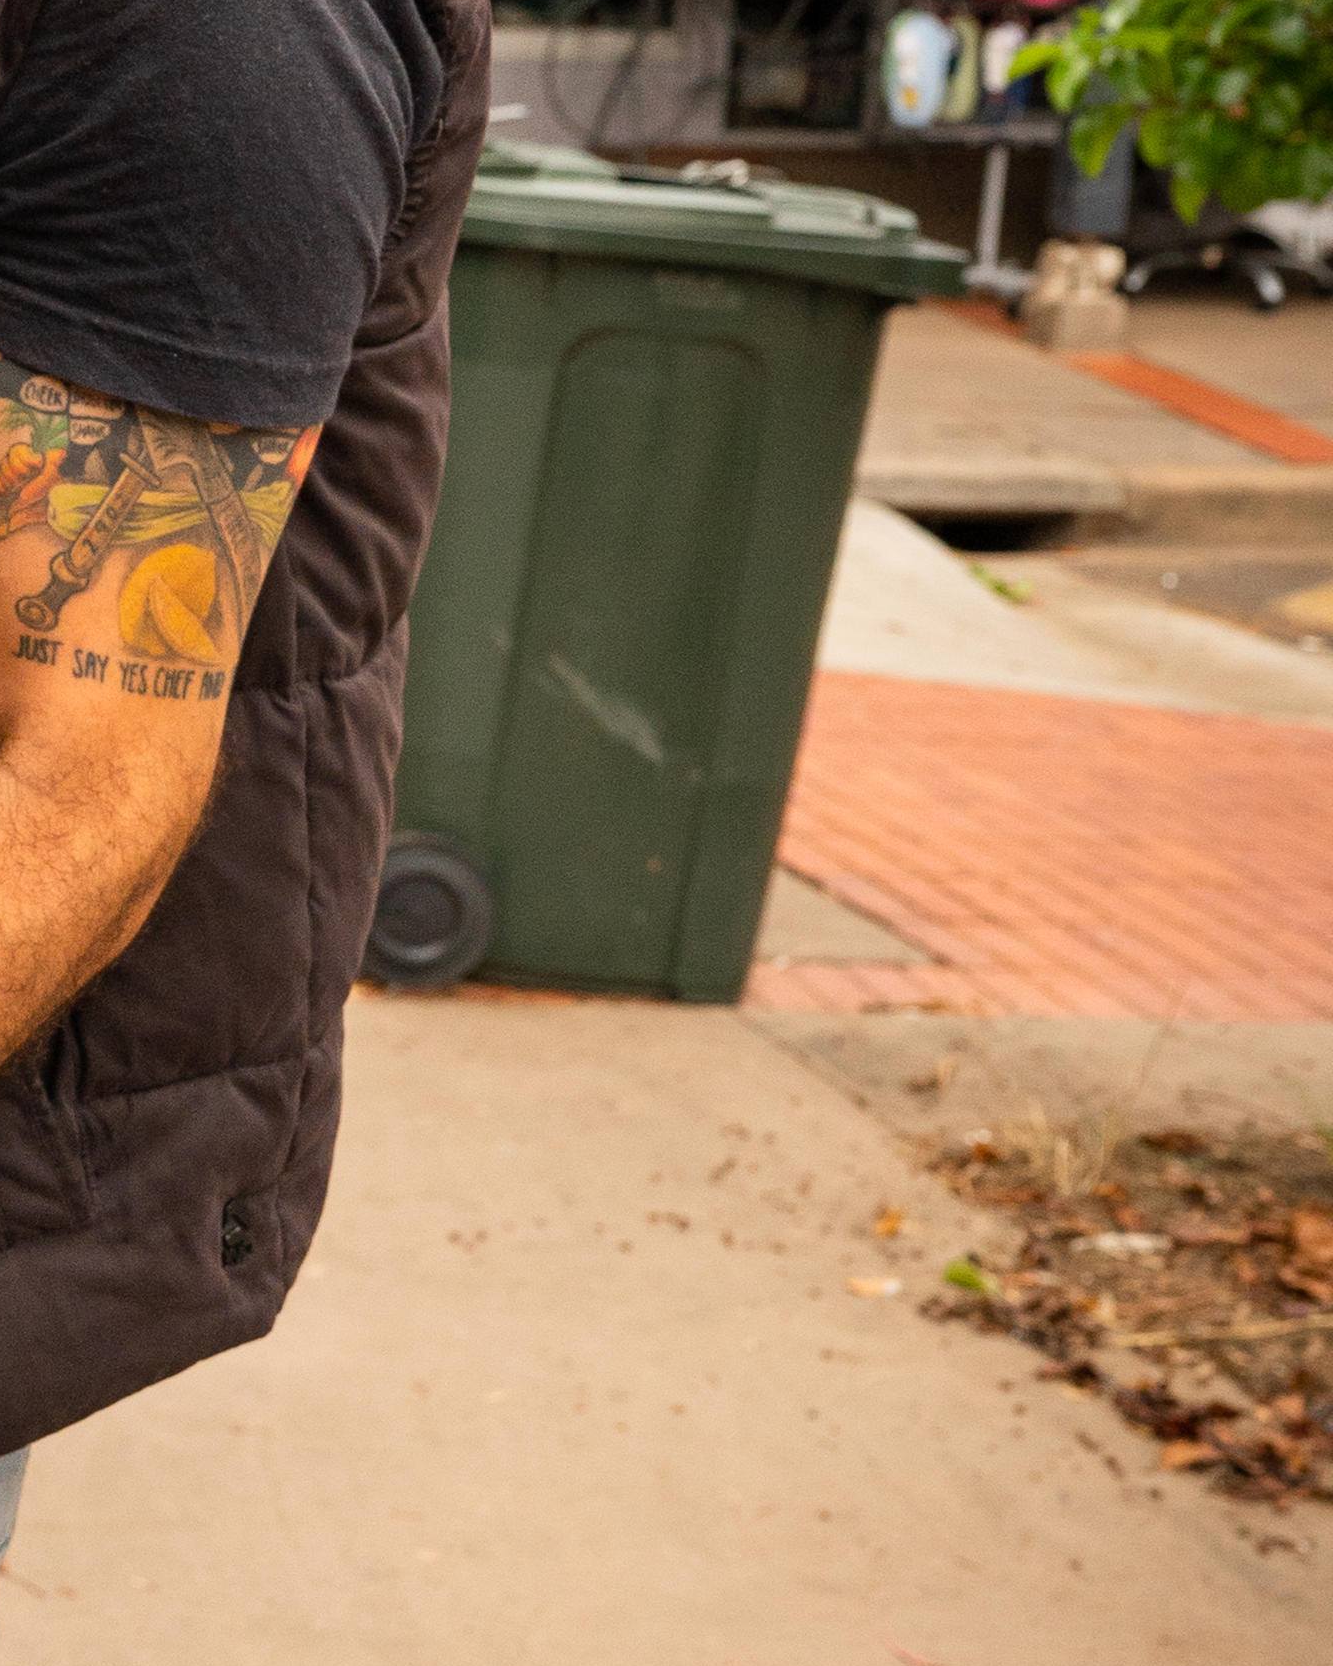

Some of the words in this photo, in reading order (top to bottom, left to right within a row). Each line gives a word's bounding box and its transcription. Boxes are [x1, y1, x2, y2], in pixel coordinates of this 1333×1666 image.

[11, 634, 63, 666] JUST
[72, 648, 109, 683] SAY
[119, 660, 149, 696] YES
[153, 665, 196, 700] CHEF
